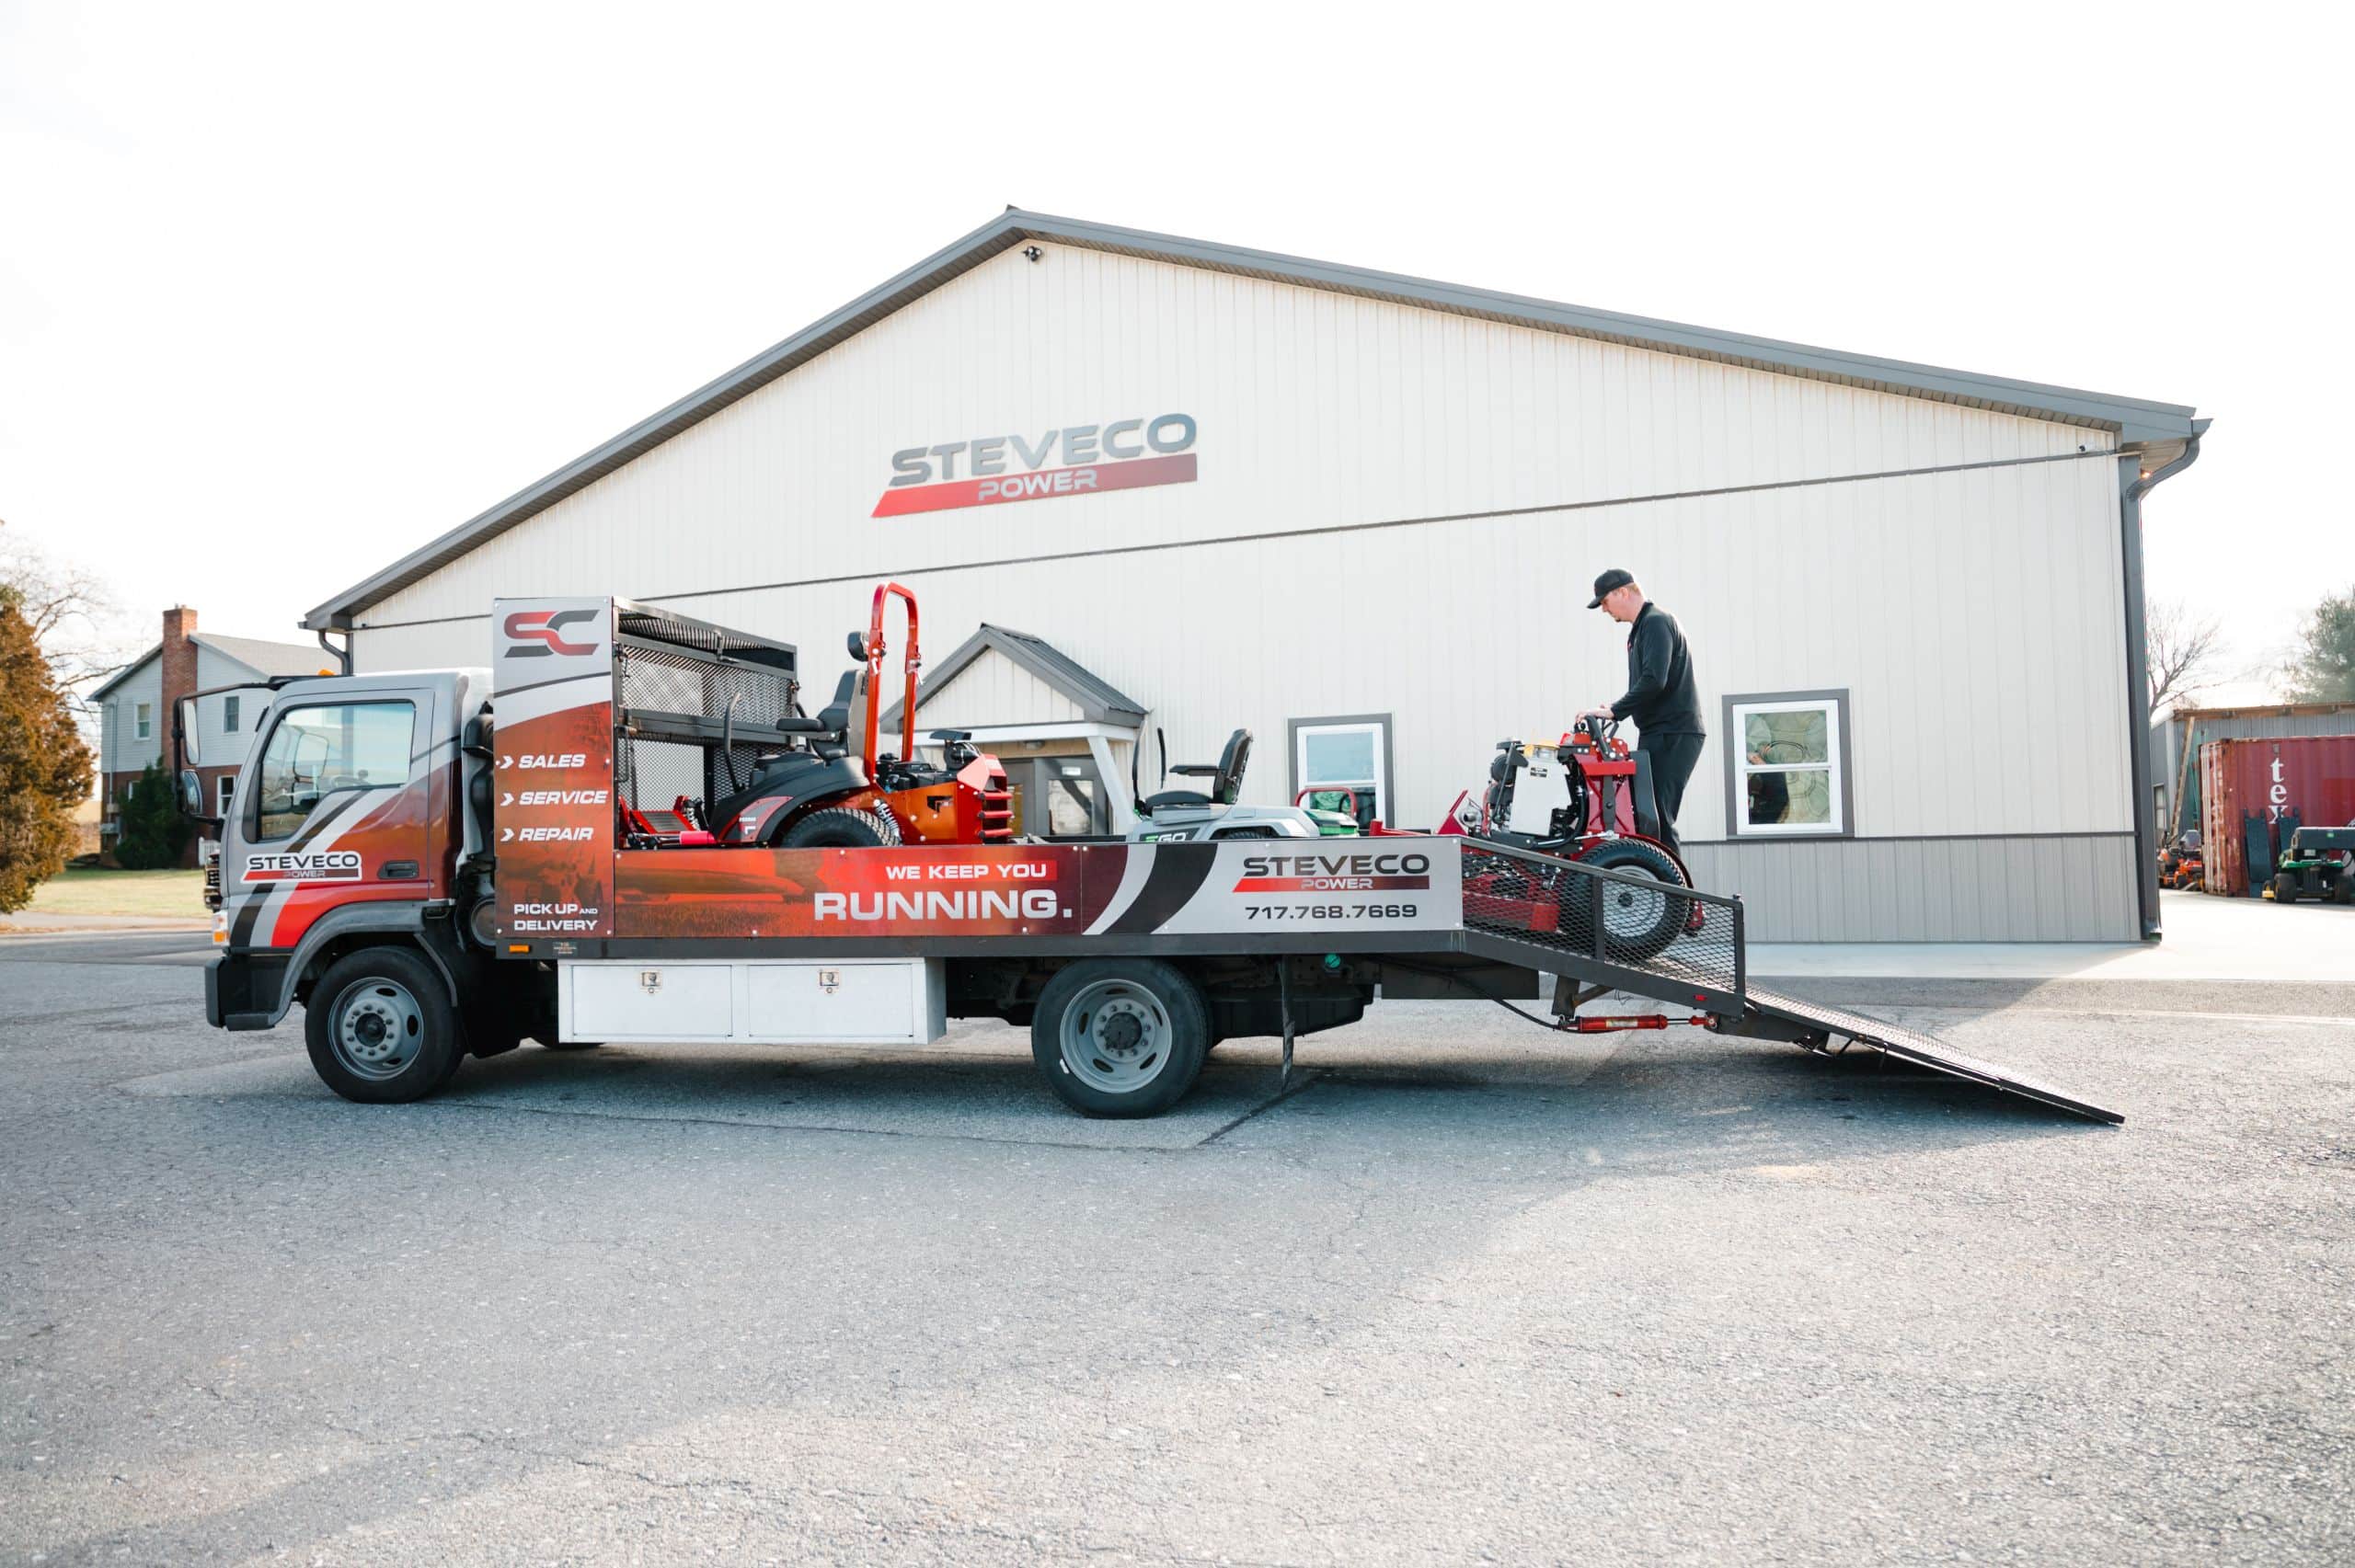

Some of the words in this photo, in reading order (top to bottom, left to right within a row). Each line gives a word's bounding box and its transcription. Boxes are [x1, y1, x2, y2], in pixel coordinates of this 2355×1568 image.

[889, 413, 1198, 486] STEVECO
[978, 469, 1097, 501] POWER
[518, 753, 587, 769] SALES
[519, 790, 609, 806] SERVICE
[518, 827, 594, 841] REPAIR
[248, 853, 360, 870] STEVECO
[1243, 853, 1430, 877] STEVECO
[283, 869, 327, 878] POWER
[885, 865, 921, 880] WE
[928, 864, 990, 879] KEEP
[996, 864, 1047, 878] YOU
[1300, 877, 1373, 890] POWER
[513, 903, 552, 915] PICK
[555, 903, 579, 915] UP
[813, 888, 1074, 921] RUNNING.
[1245, 904, 1419, 920] 717.768.7669
[513, 920, 598, 932] DELIVERY
